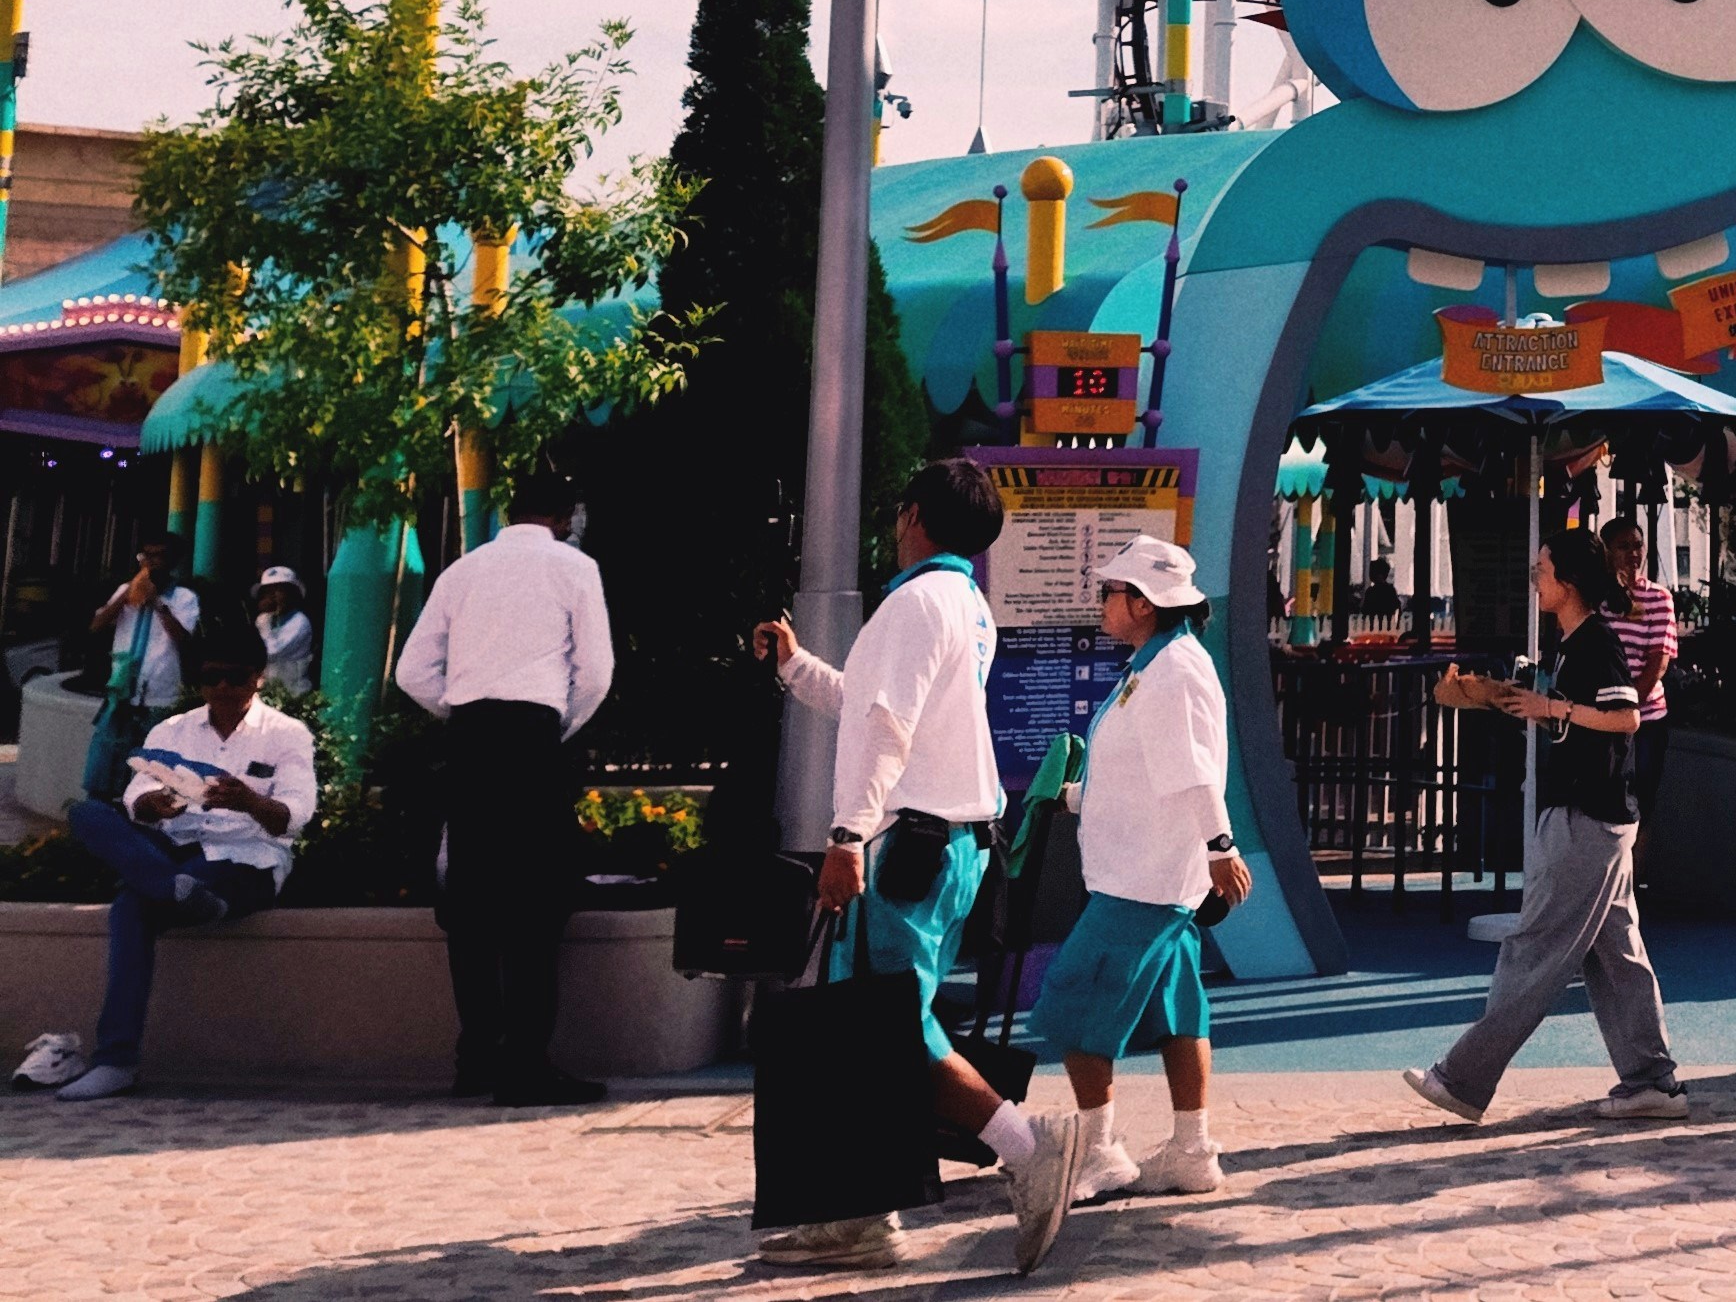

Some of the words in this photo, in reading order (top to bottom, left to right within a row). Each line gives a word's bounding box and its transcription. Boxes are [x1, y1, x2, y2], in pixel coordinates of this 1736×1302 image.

[1473, 329, 1579, 351] ATTRACTION
[1480, 352, 1569, 372] ENTRANCE
[1061, 405, 1110, 415] MINUTES
